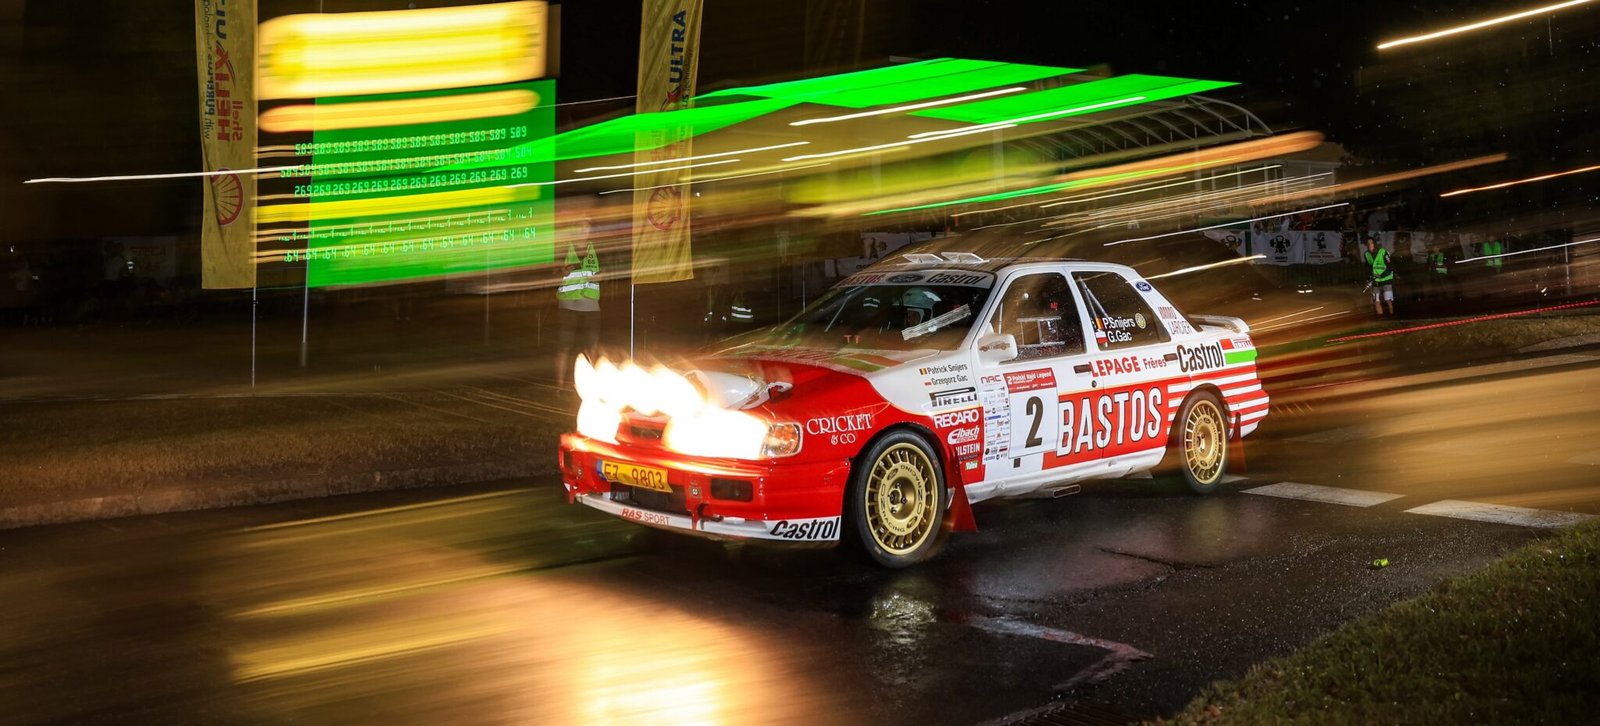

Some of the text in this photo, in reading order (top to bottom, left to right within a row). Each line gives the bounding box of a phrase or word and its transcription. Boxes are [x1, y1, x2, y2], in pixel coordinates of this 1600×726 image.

[669, 8, 687, 84] ULTRA
[926, 272, 986, 286] Castrol
[1102, 317, 1136, 330] P.Snijers
[1108, 331, 1132, 343] G.Gac
[1088, 354, 1167, 378] LEPAGE Frères
[1176, 342, 1224, 373] Castrol
[927, 363, 968, 375] Patrick Snijers
[931, 374, 968, 386] Grzegorz Gac
[1006, 376, 1013, 385] 2
[929, 386, 977, 407] PIRELLI
[806, 413, 873, 435] CRICKET
[933, 409, 979, 429] RECARO
[1025, 396, 1044, 448] 2
[1056, 387, 1162, 457] BASTOS
[831, 433, 856, 445] & CO
[955, 442, 980, 456] ILSTEIN
[631, 468, 665, 490] 9803
[622, 508, 671, 526] RAS SPORT
[769, 518, 839, 540] Castrol
